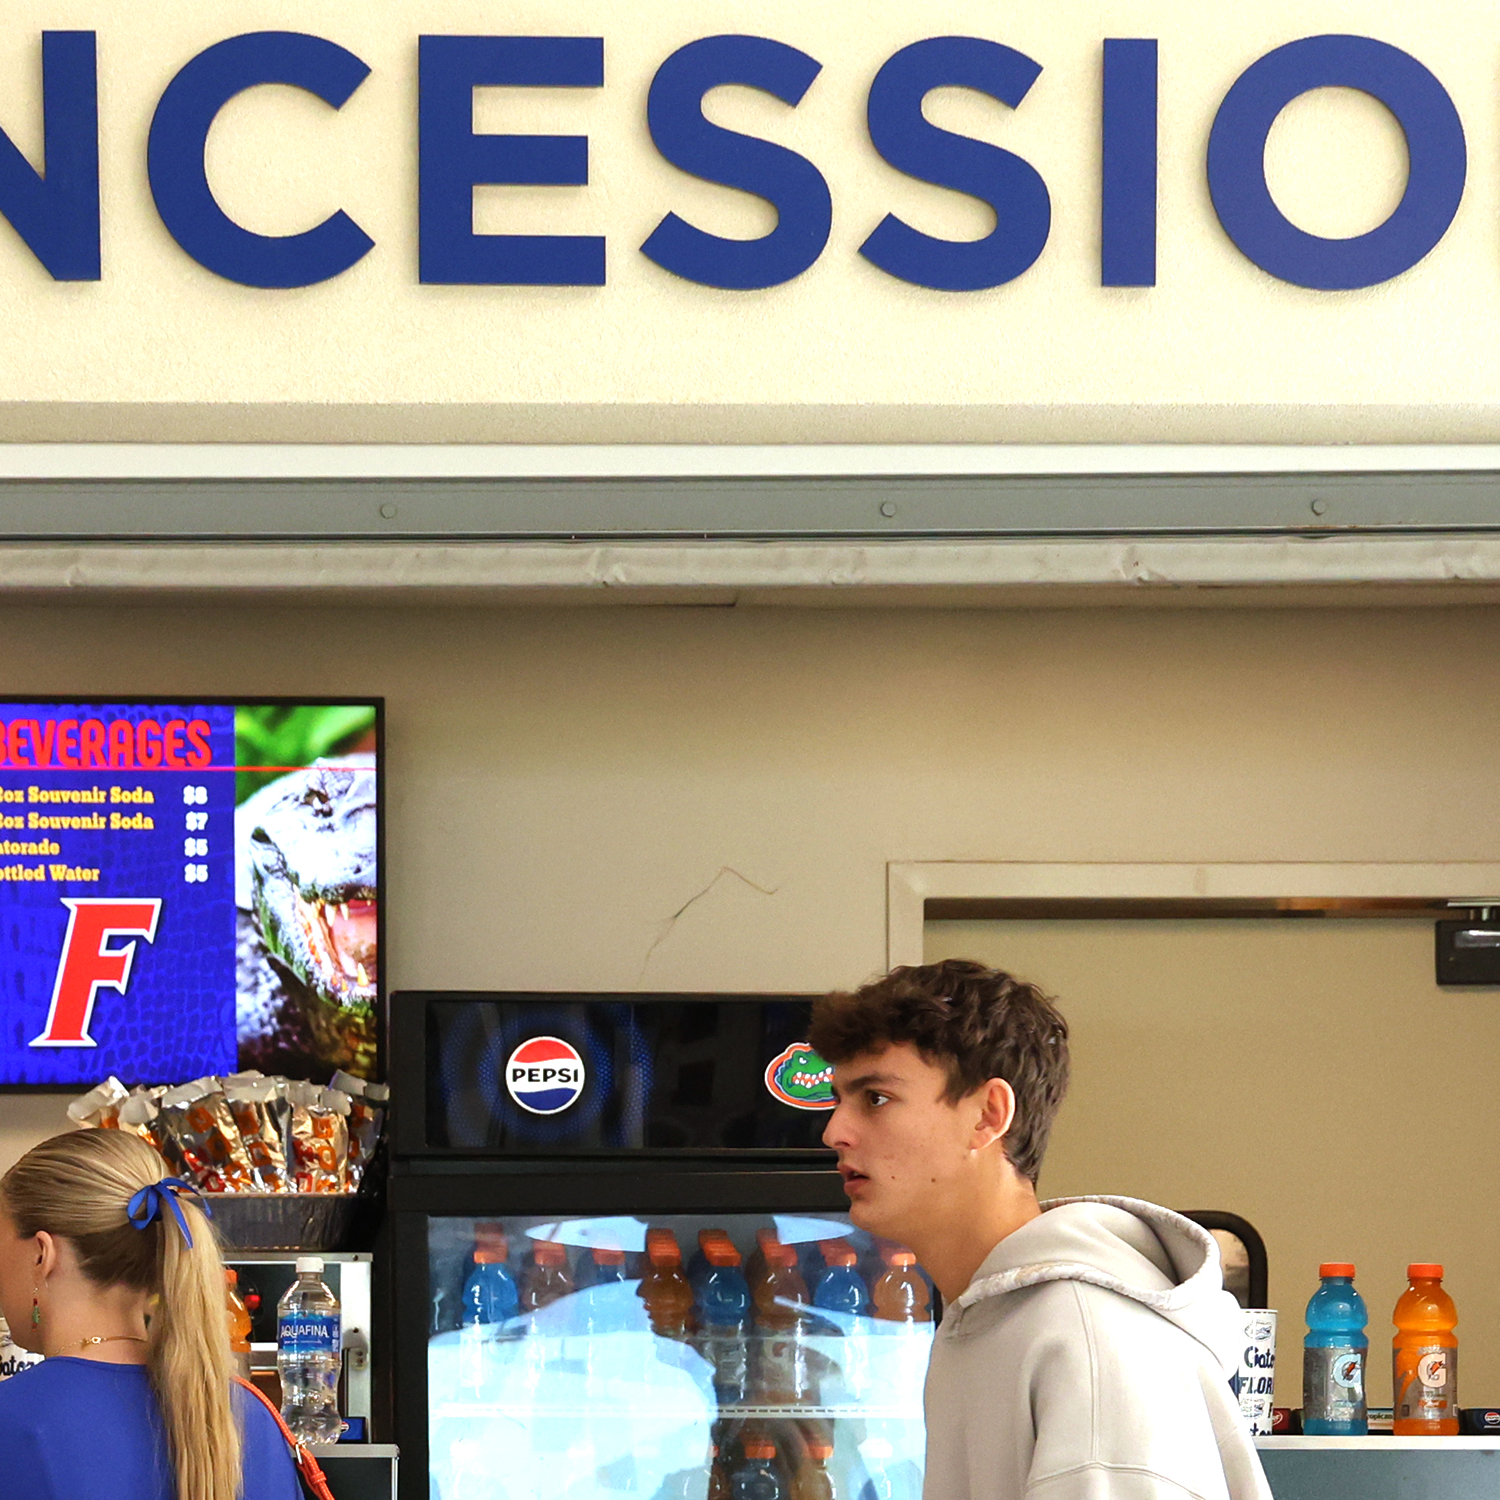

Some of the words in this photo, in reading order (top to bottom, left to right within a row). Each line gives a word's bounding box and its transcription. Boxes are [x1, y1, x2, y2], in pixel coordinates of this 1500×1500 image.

[28, 786, 107, 803] Souvenir
[110, 786, 154, 804] Soda
[183, 785, 208, 806] $8
[28, 812, 107, 829] Souvenir
[110, 812, 154, 830] Soda
[185, 811, 208, 832] $7
[184, 837, 208, 858] $5
[48, 864, 100, 882] Water
[184, 863, 208, 884] $5
[28, 898, 162, 1047] F
[513, 1068, 579, 1083] PEPSI
[280, 1325, 330, 1338] AQUAFINA
